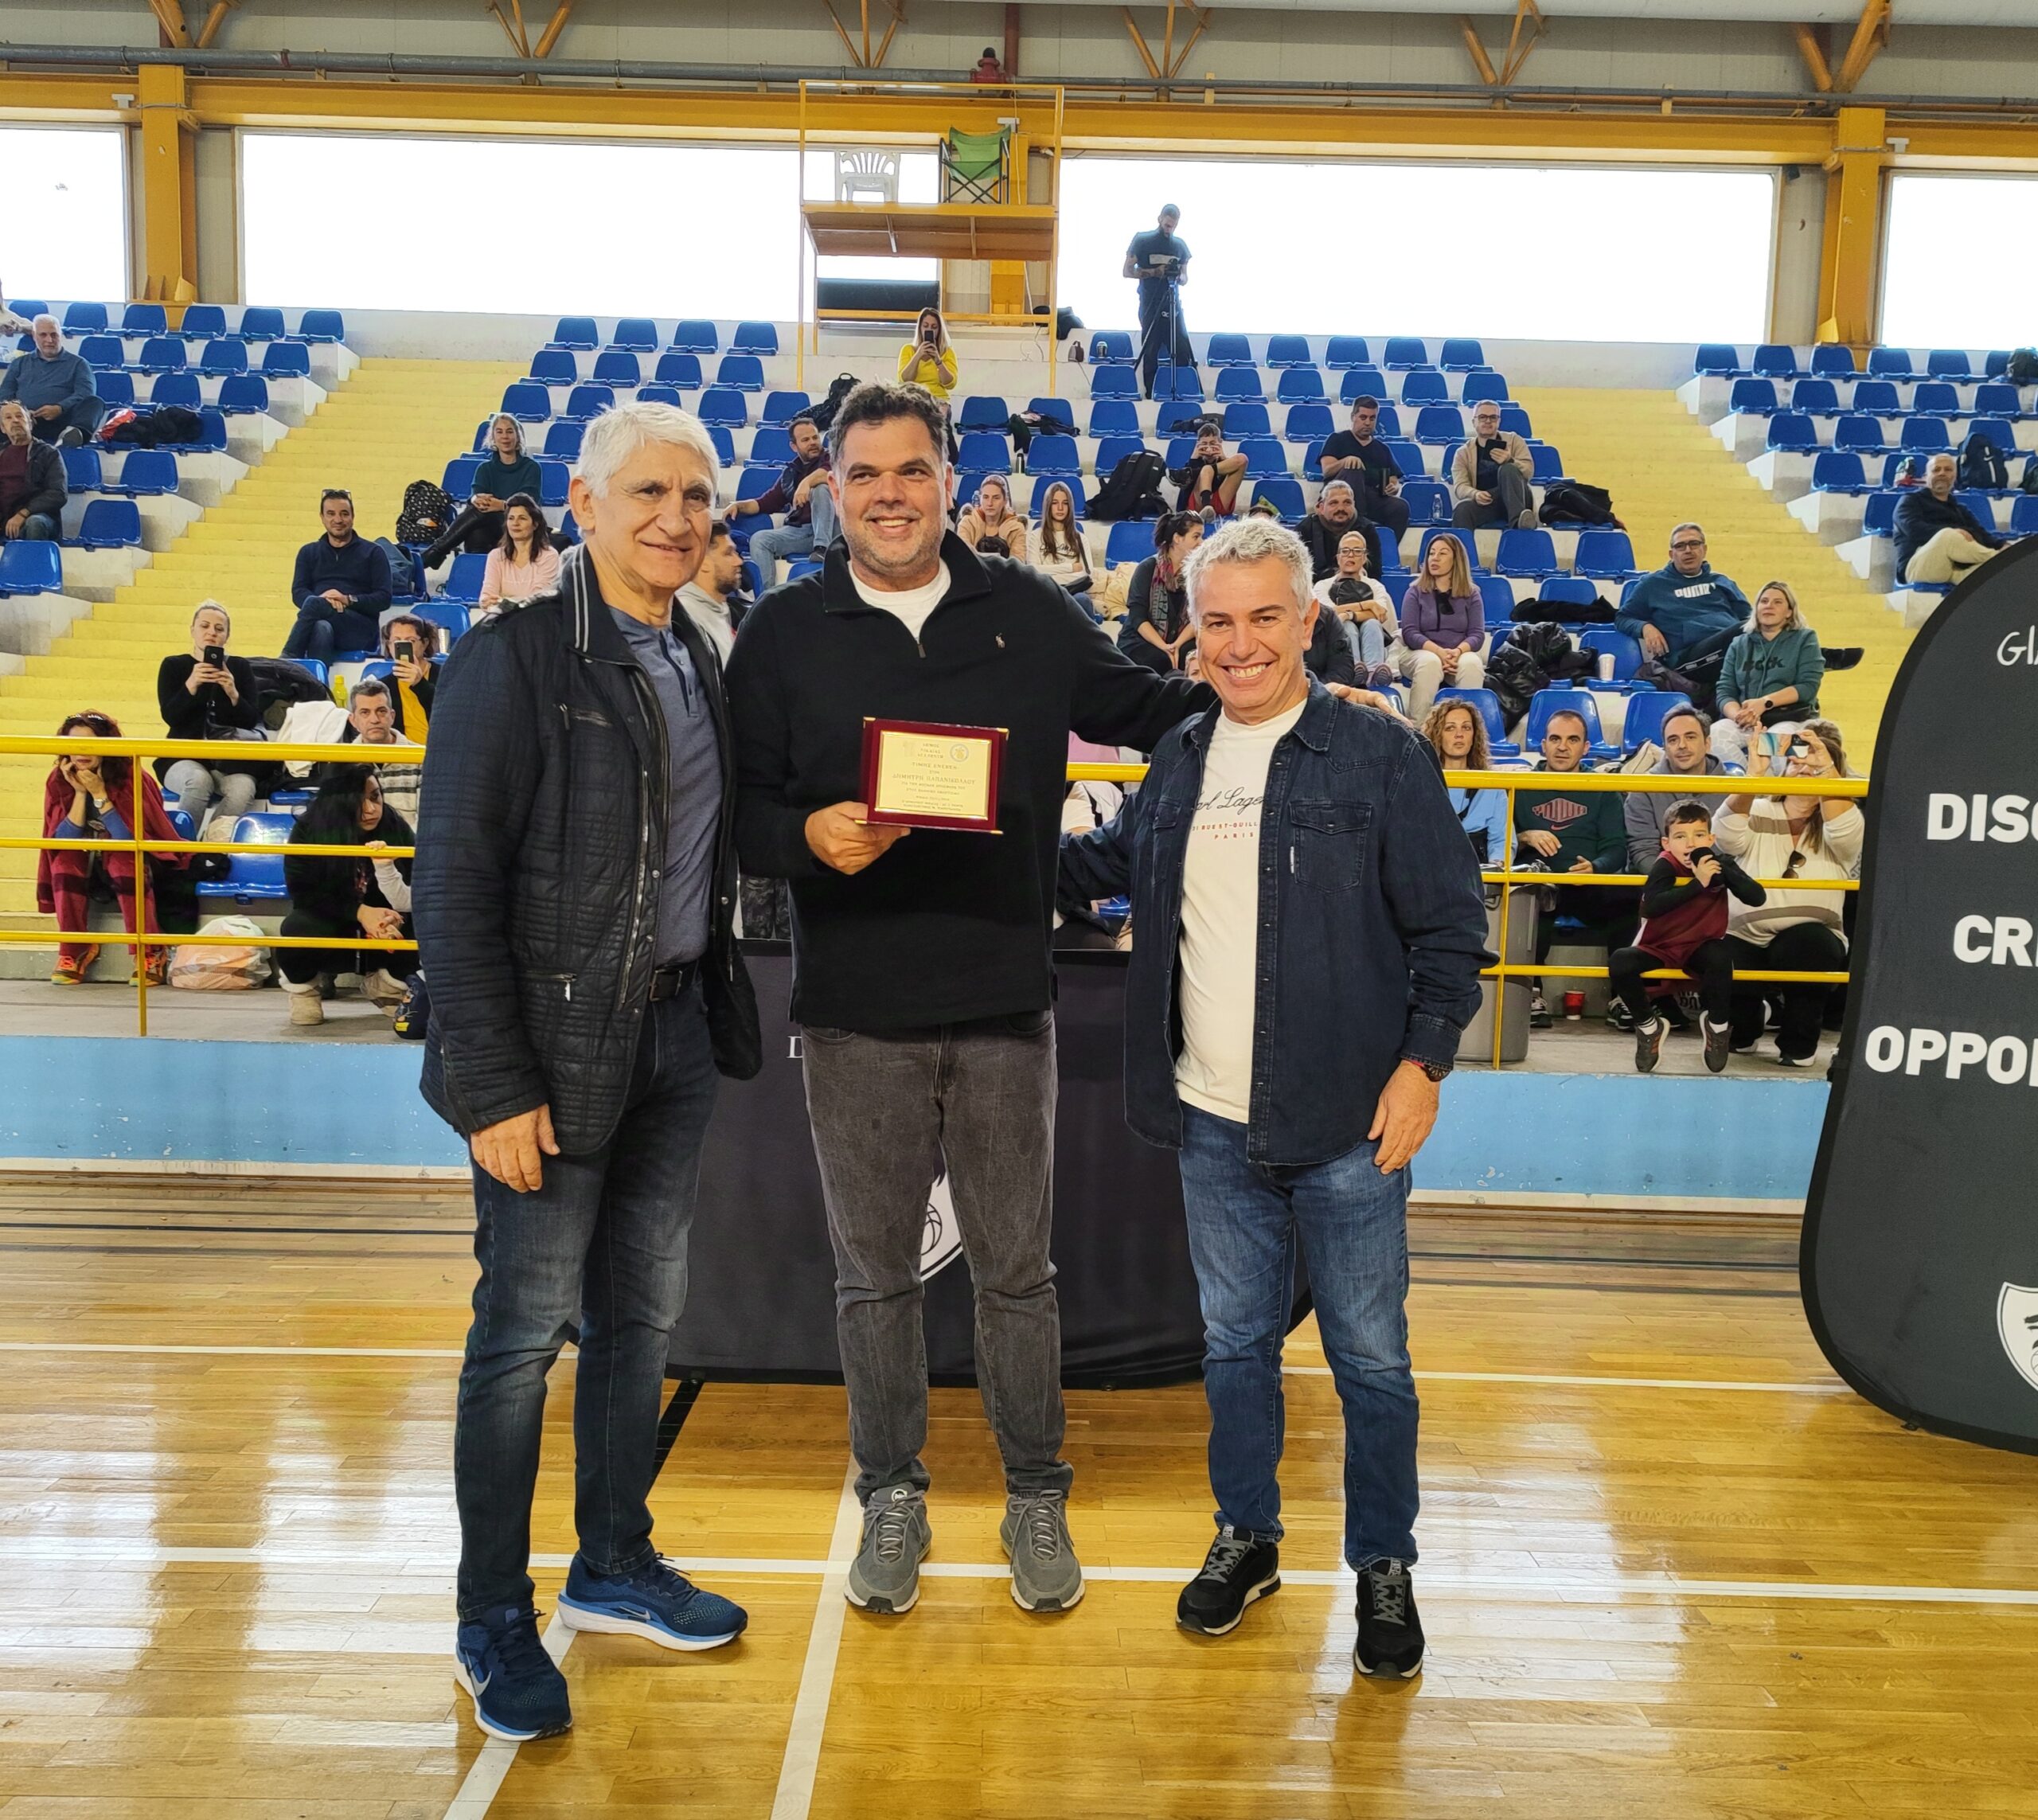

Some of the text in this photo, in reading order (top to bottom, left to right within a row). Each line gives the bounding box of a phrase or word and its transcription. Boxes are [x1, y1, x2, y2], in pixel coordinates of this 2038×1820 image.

[1196, 786, 1264, 815] arl Lage
[1927, 793, 2038, 844] DIS
[1953, 915, 2038, 967] CR
[1865, 1025, 2038, 1087] OPPO
